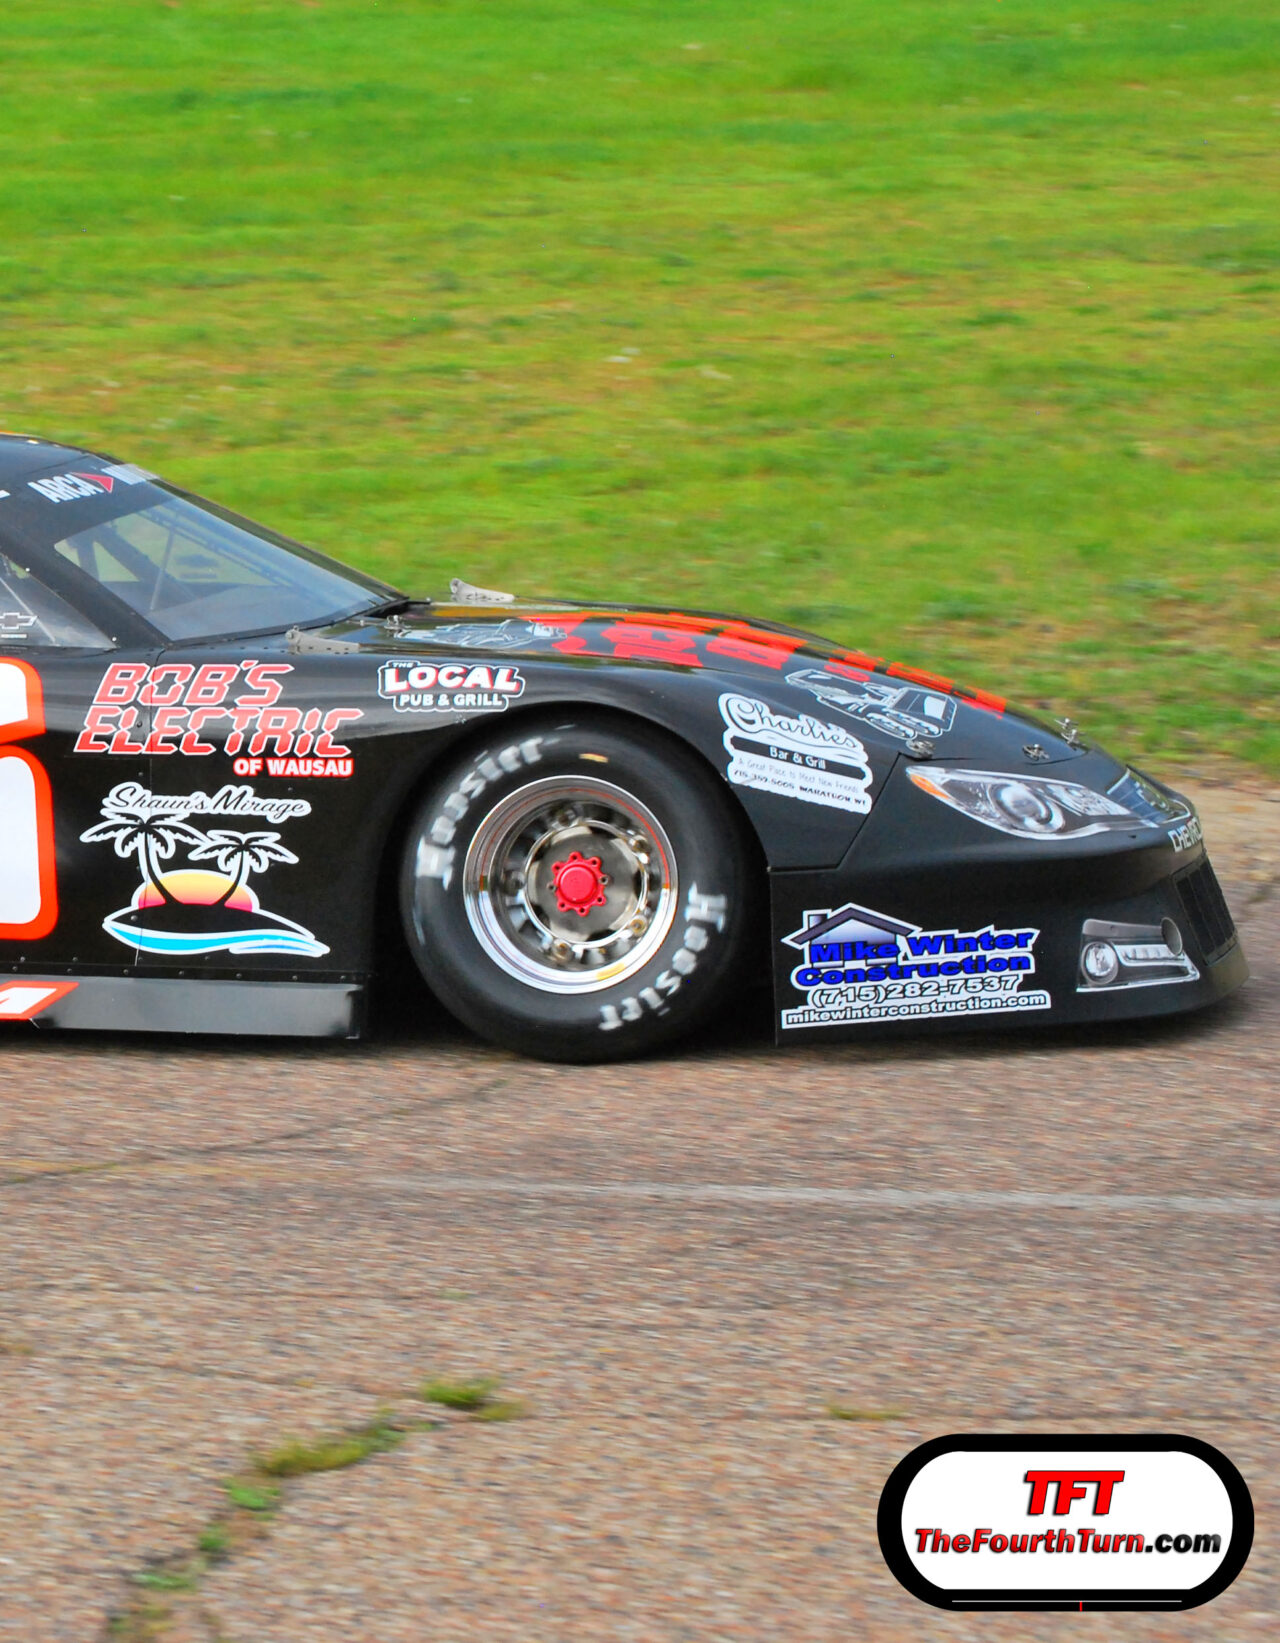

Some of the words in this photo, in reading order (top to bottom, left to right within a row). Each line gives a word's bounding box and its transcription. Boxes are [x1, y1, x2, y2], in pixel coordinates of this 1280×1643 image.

[27, 472, 106, 504] ARCA
[92, 660, 295, 707] BOB'S
[383, 665, 521, 692] LOCAL
[399, 693, 435, 707] PUB
[437, 693, 450, 706] &
[452, 693, 503, 708] GRILL
[73, 706, 365, 758] ELECTRIC
[233, 758, 264, 776] OF
[266, 758, 355, 778] WAUSAU
[769, 746, 788, 760] Bar
[792, 752, 803, 765] &
[805, 755, 827, 770] Grill
[108, 785, 208, 810] Shaun's
[212, 788, 307, 820] Mirage
[809, 941, 900, 965] Mike
[906, 930, 1035, 957] Winter
[794, 954, 1032, 987] Construction
[810, 975, 1020, 1008] (715)282-7537
[786, 993, 1046, 1026] mikewinterconstruction.com
